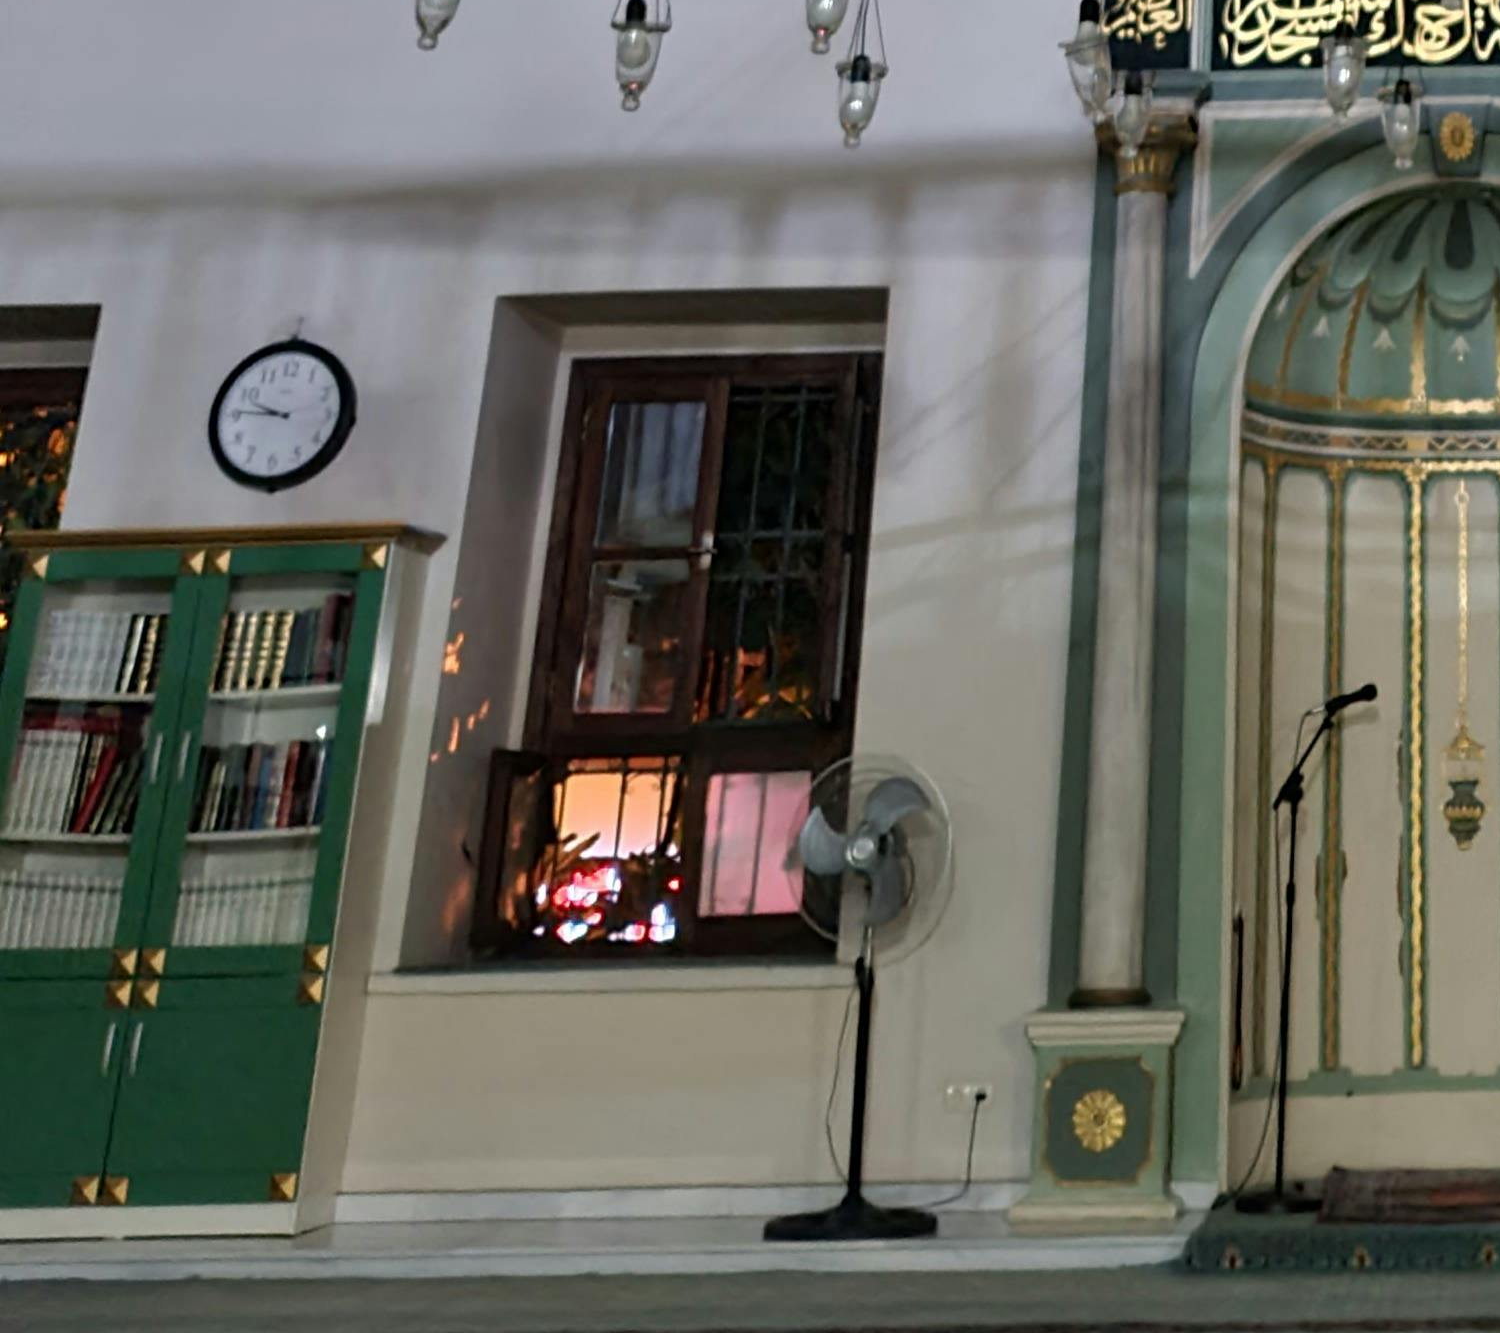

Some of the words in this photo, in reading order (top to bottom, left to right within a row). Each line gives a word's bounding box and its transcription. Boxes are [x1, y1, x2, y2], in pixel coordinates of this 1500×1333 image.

[261, 369, 276, 383] 11
[283, 361, 299, 378] 12
[241, 386, 260, 402] 10
